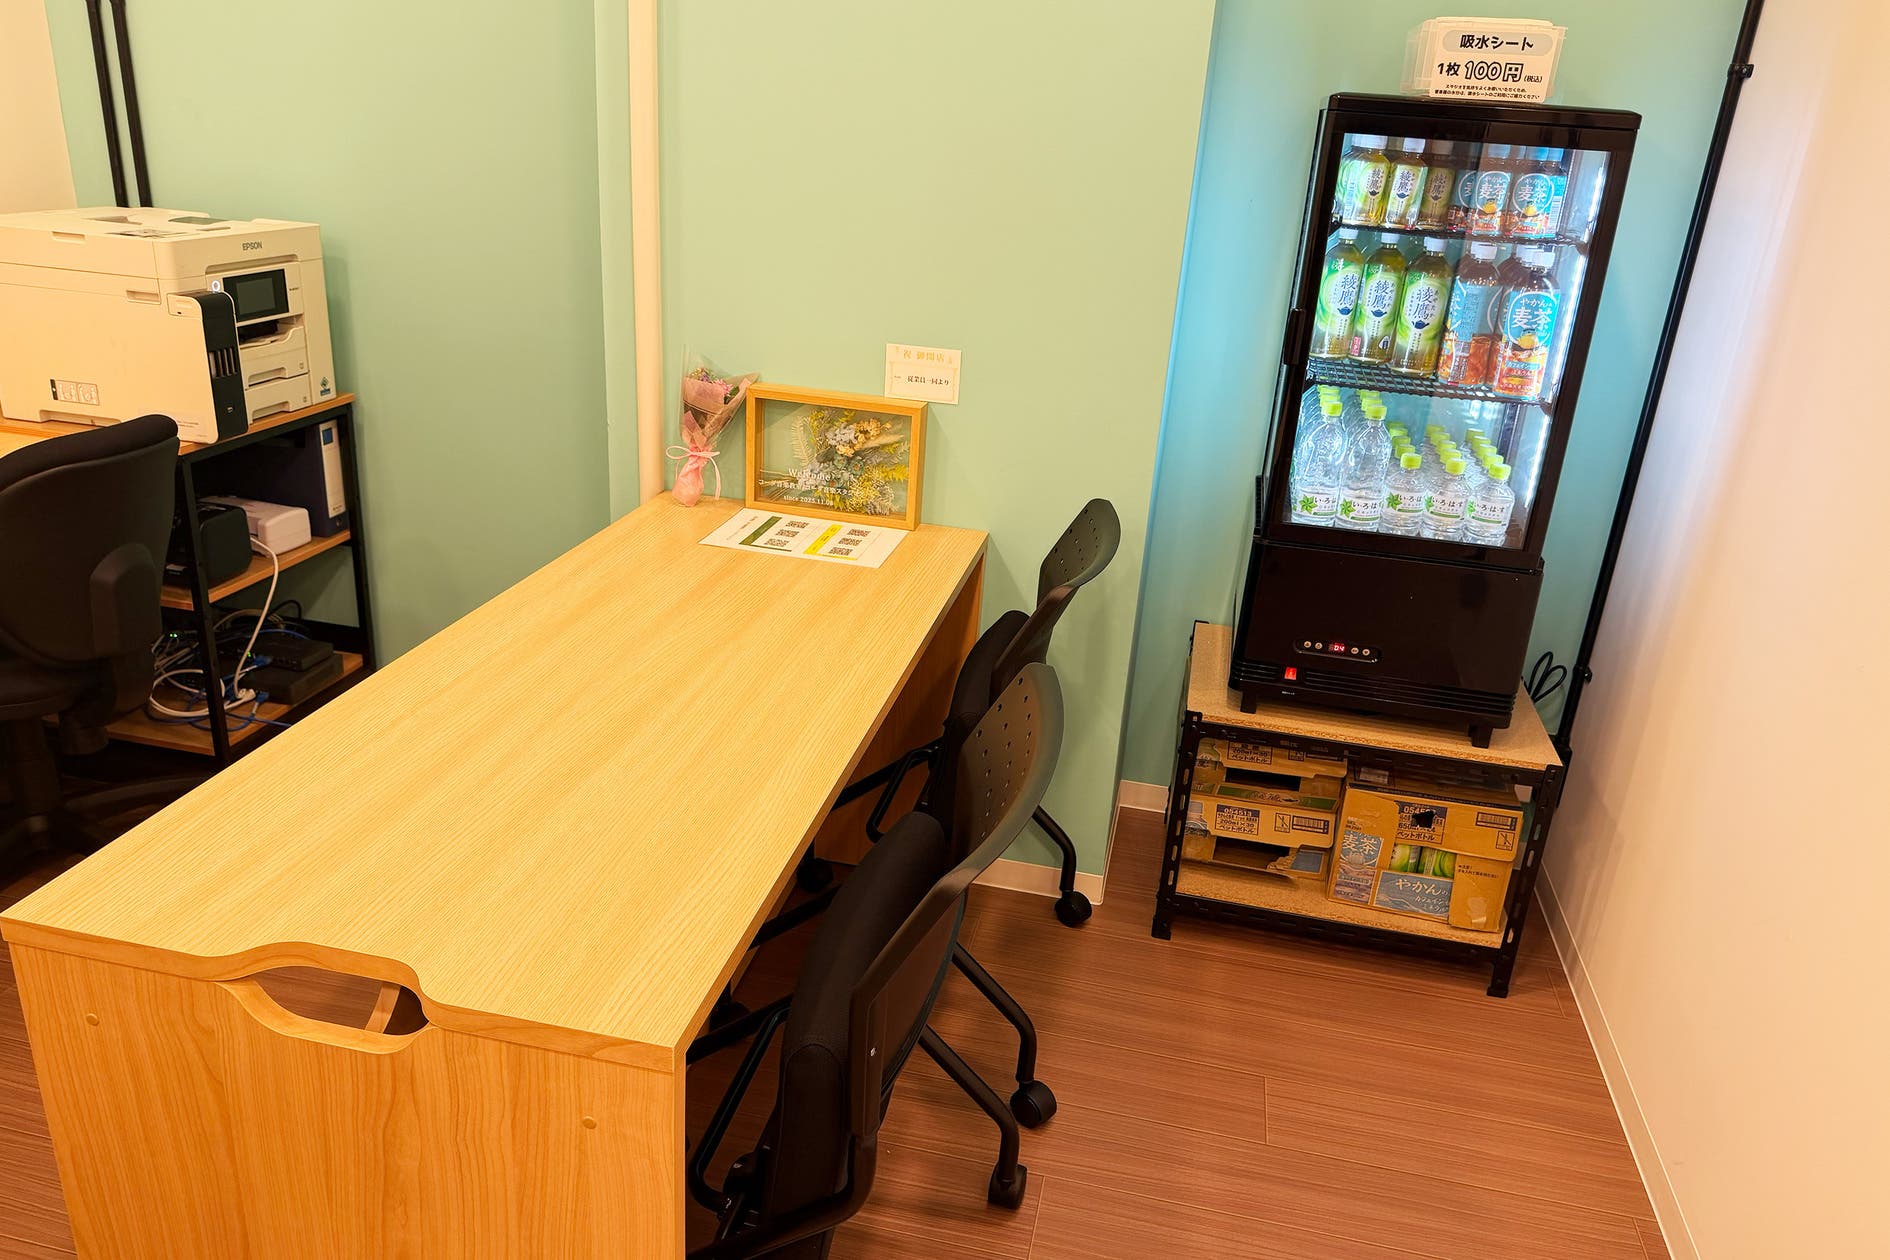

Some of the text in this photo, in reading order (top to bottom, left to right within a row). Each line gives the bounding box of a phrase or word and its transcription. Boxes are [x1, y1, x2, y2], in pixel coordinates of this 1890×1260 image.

[1459, 34, 1534, 51] 吸水シート
[1437, 61, 1461, 77] 1枚
[1464, 60, 1524, 82] 100円
[1518, 185, 1548, 203] 麦茶
[242, 241, 263, 250] EPSON
[1339, 274, 1358, 307] 綾鷹
[1372, 279, 1389, 309] 綾鷹
[1412, 287, 1433, 320] 綾鷹
[1511, 306, 1552, 330] 麦茶
[789, 468, 830, 480] Welcome
[1343, 831, 1378, 855] 麦茶
